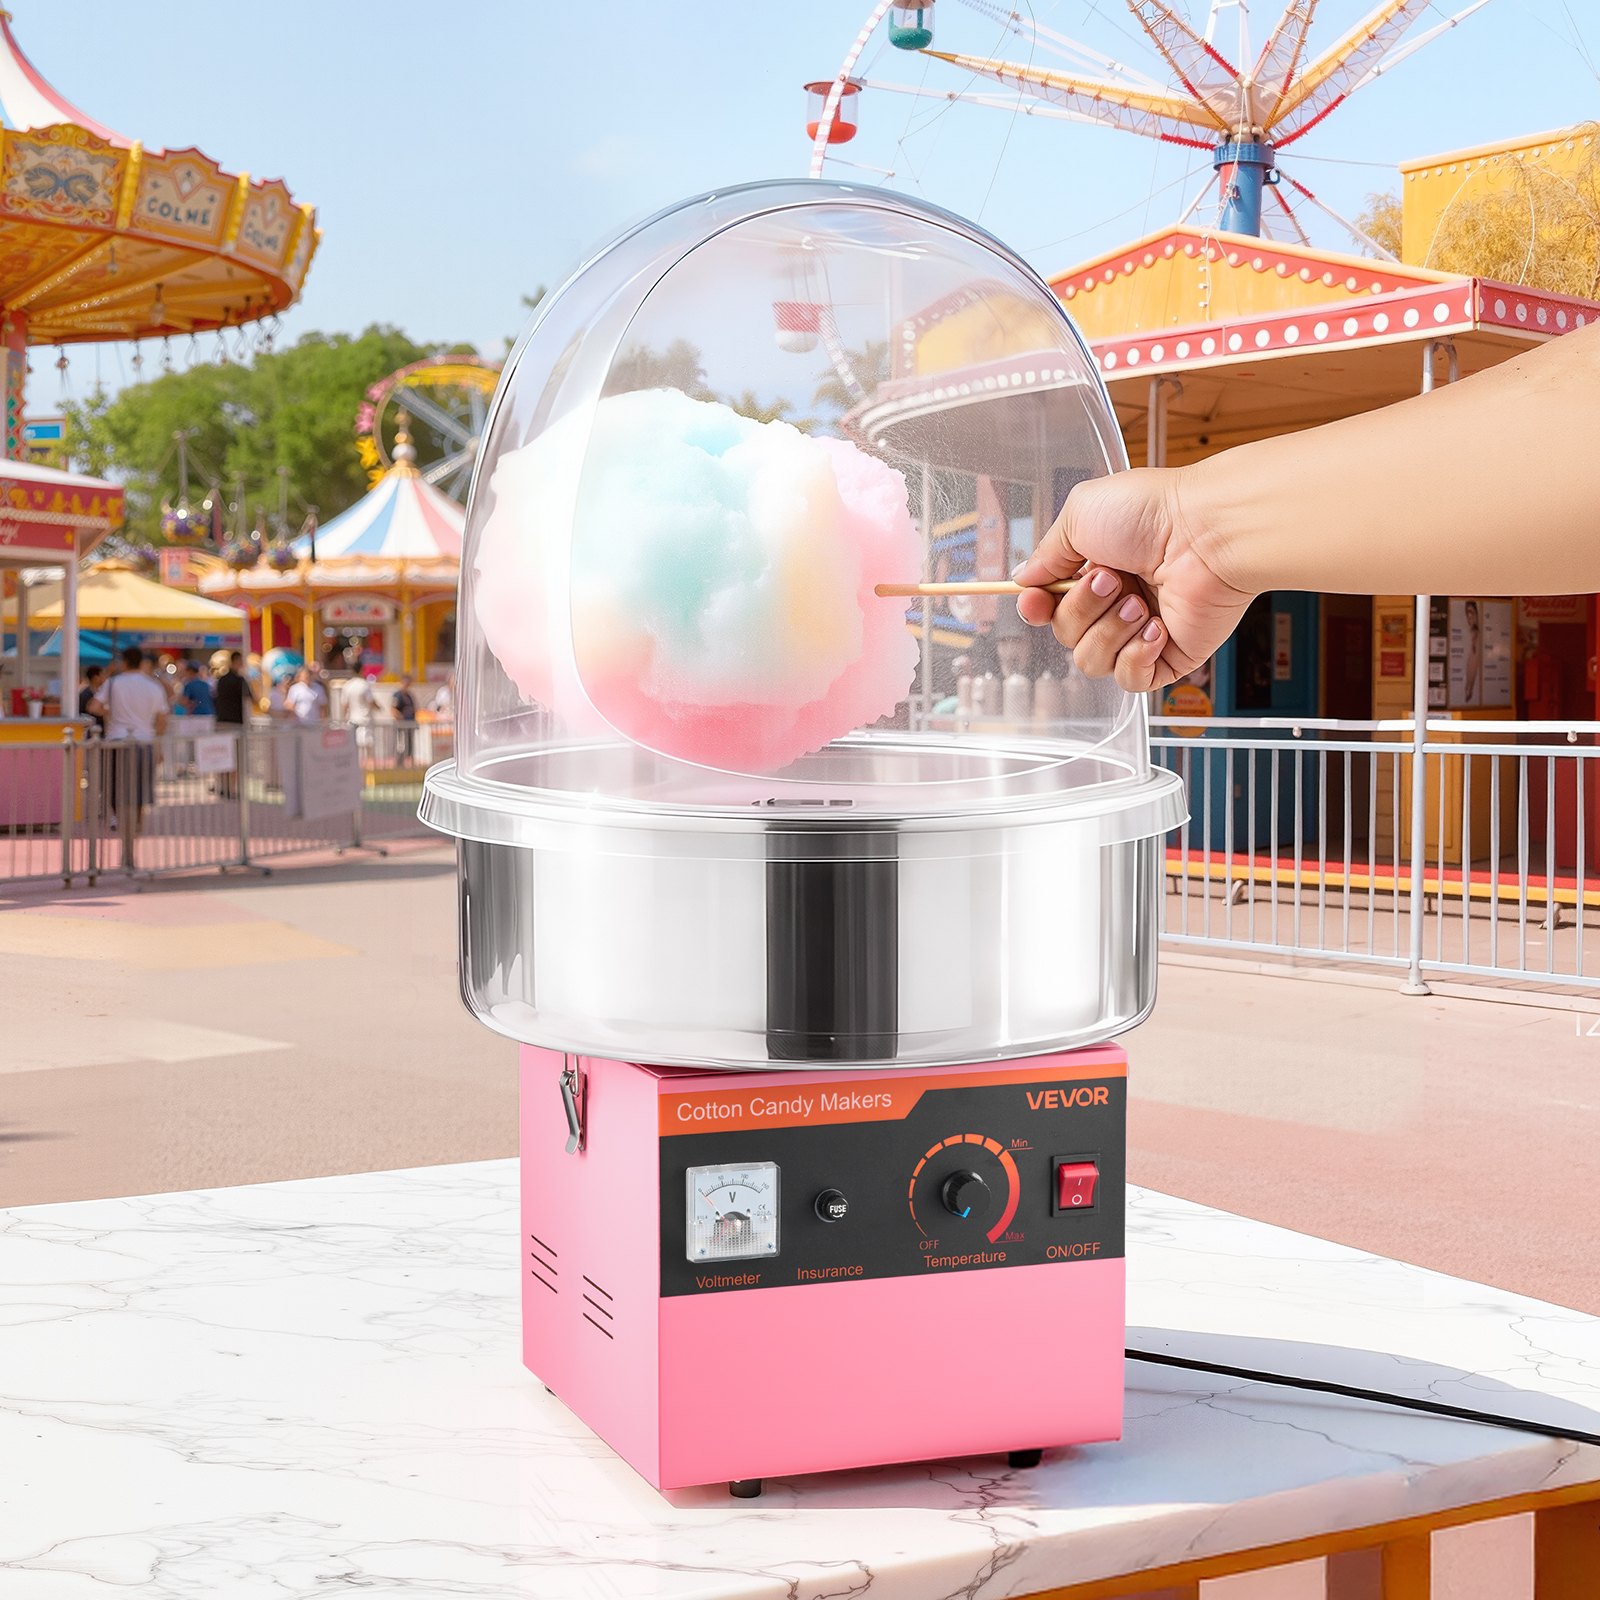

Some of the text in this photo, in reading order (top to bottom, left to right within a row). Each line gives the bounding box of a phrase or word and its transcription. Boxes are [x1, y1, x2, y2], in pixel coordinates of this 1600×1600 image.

[1025, 1086, 1109, 1110] VEVOR
[677, 1092, 893, 1121] Cotton Candy Makers
[1011, 1138, 1029, 1148] Min
[729, 1191, 736, 1203] V
[829, 1204, 847, 1213] FUSE
[1005, 1231, 1025, 1240] Max
[919, 1239, 940, 1250] OFF
[1046, 1242, 1101, 1259] ON/OFF
[923, 1251, 1007, 1268] Temperature
[797, 1265, 863, 1280] Insurance
[696, 1273, 761, 1289] Voltmeter
